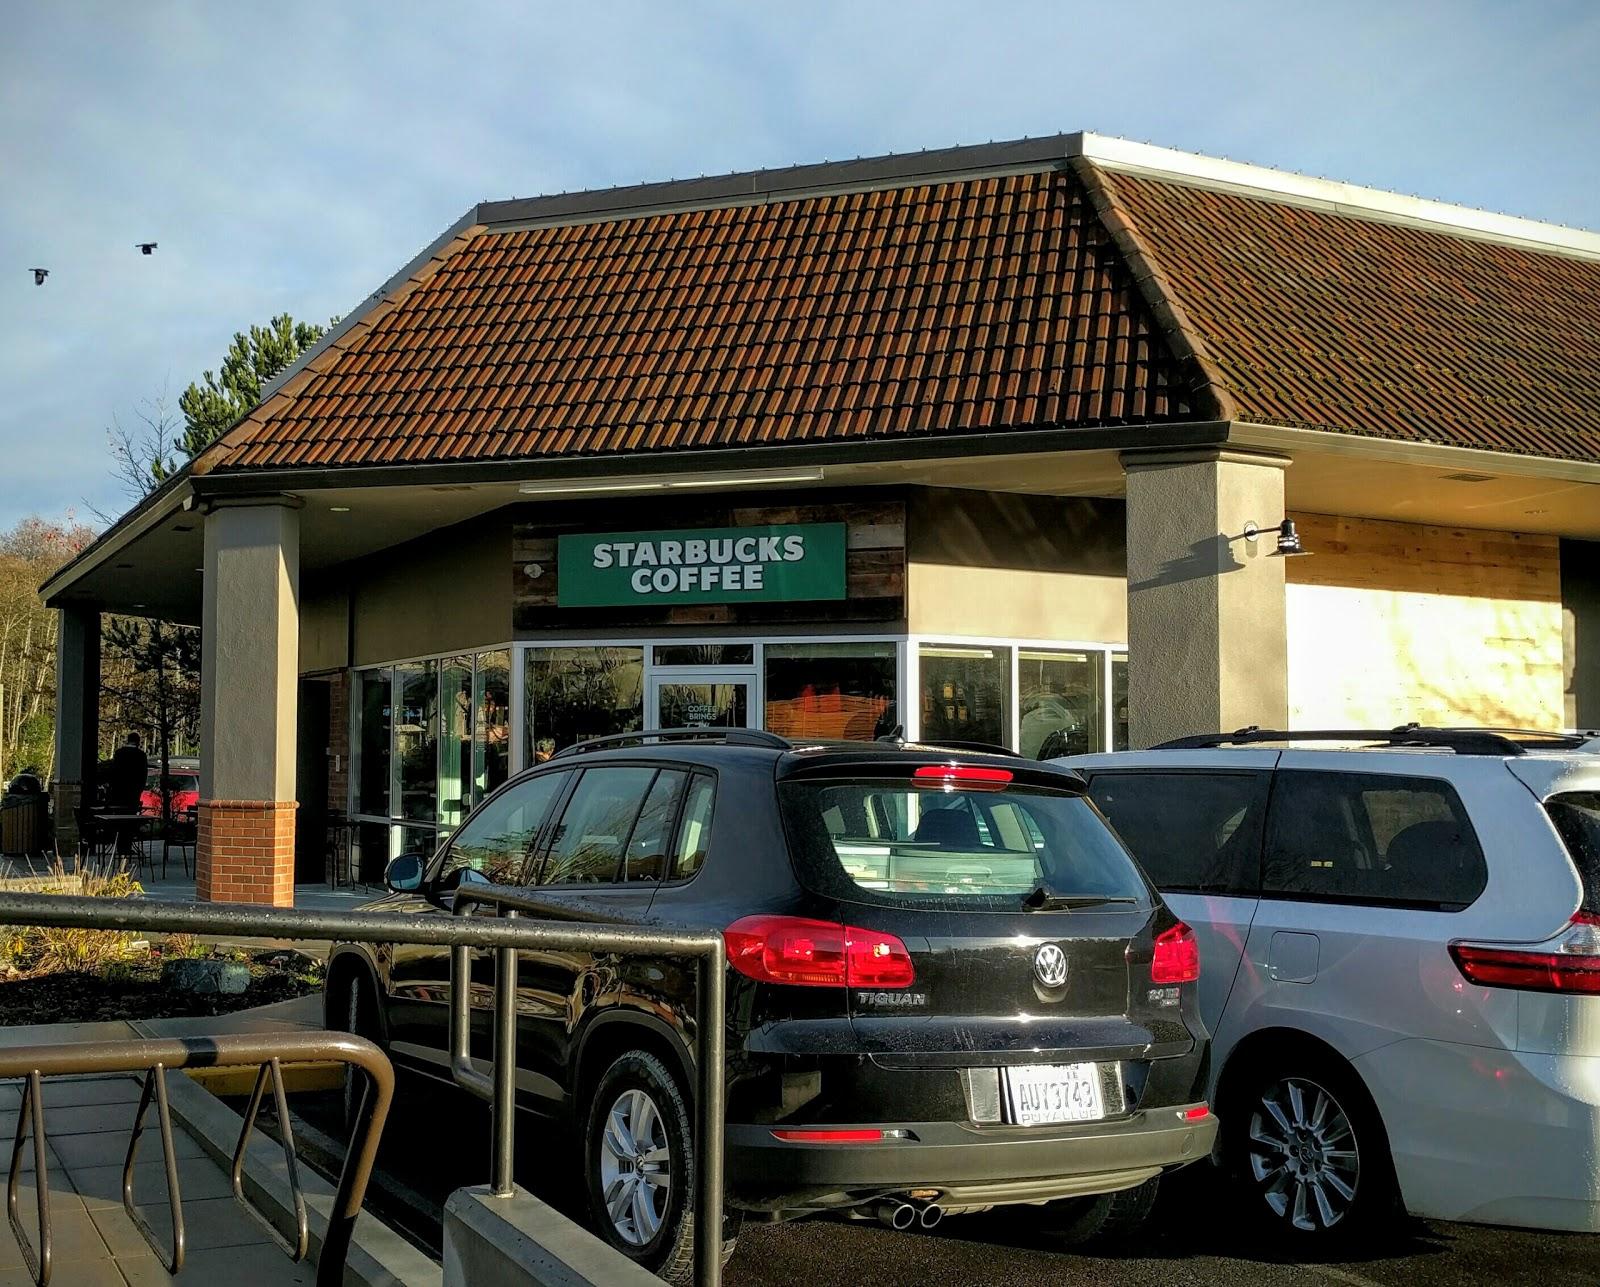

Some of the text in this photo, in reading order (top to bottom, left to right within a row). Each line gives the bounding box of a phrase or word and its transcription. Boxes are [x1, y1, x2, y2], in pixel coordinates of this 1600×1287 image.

[593, 536, 805, 568] STARBUCKS
[631, 565, 764, 593] COFFEE
[687, 705, 717, 713] COFFEE
[689, 712, 717, 721] BRINGS
[857, 992, 926, 1007] TIGUAN
[1021, 1109, 1098, 1123] PUYALLUP
